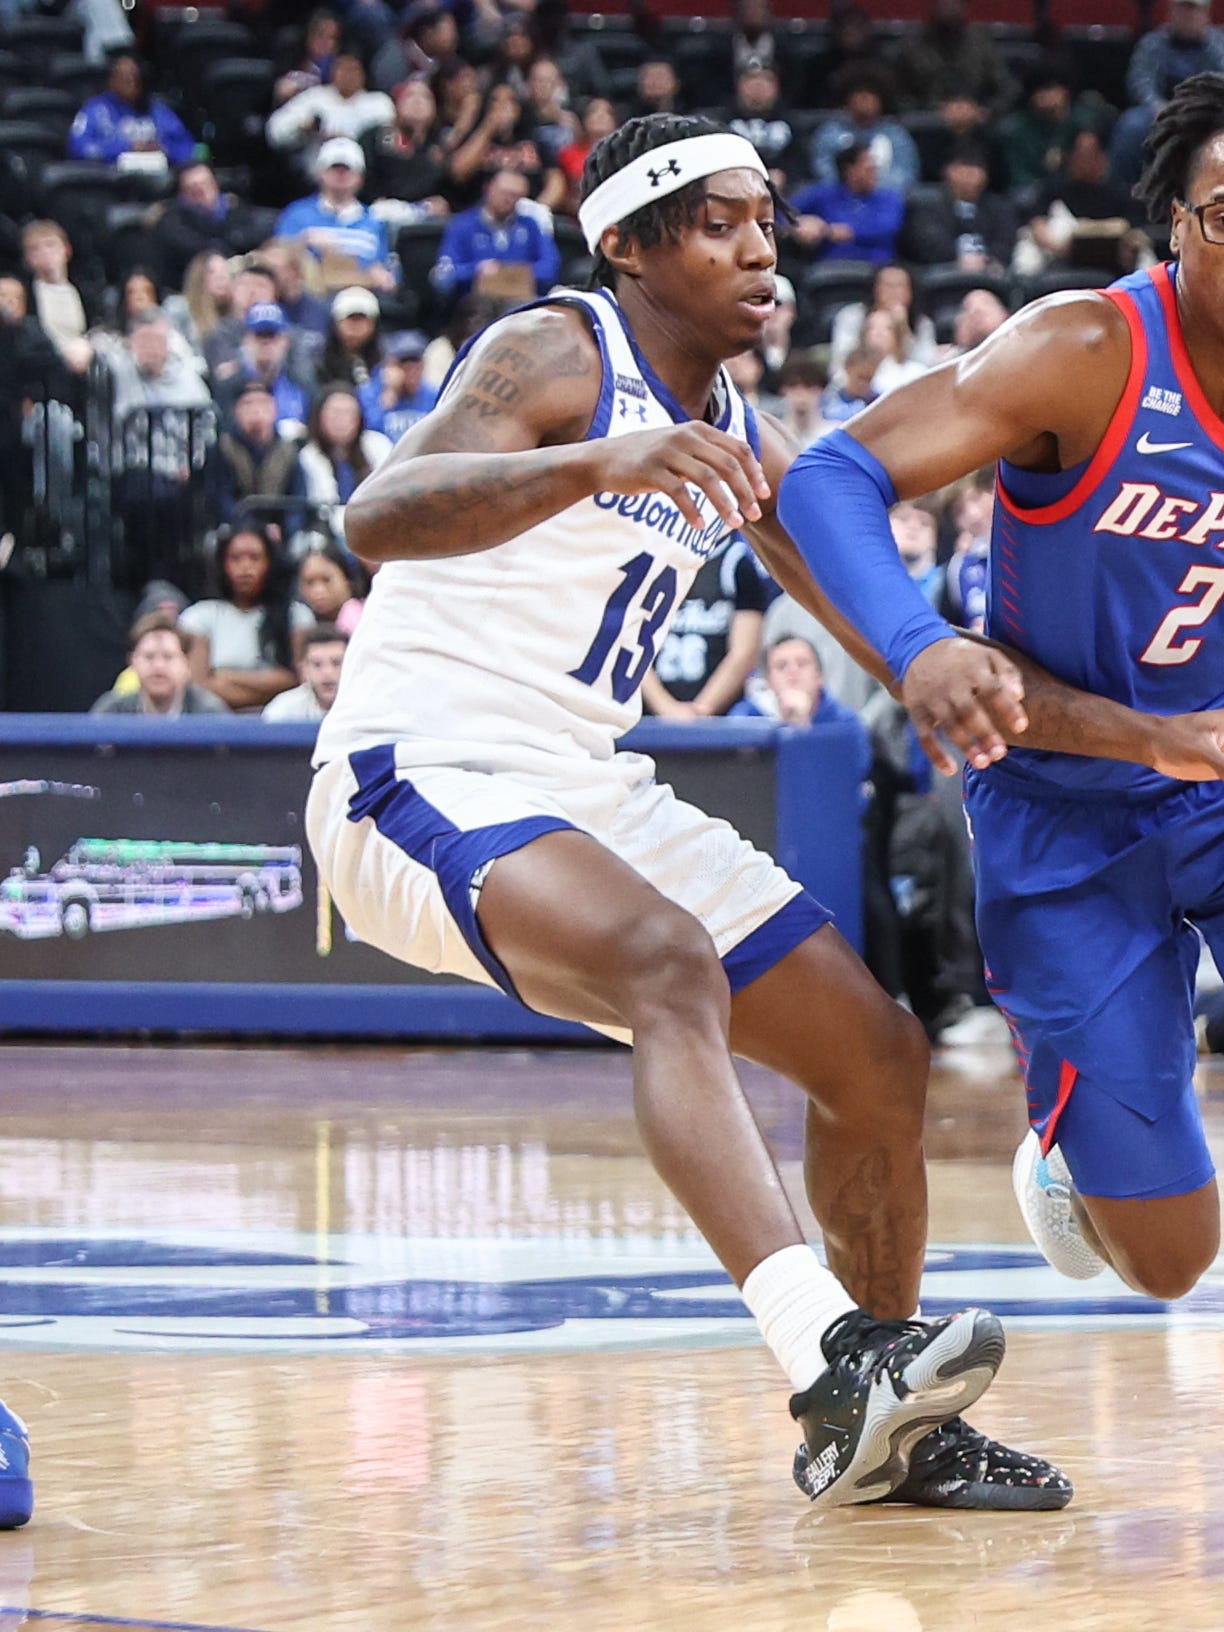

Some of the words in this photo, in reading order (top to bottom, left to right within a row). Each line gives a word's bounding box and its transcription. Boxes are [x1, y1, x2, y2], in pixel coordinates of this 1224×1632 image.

[1141, 396, 1182, 417] CHANGE
[1149, 385, 1163, 400] BE
[1163, 389, 1182, 405] THE
[565, 549, 678, 706] 13
[805, 1440, 840, 1483] GALLERY
[813, 1462, 840, 1494] DEPT.
